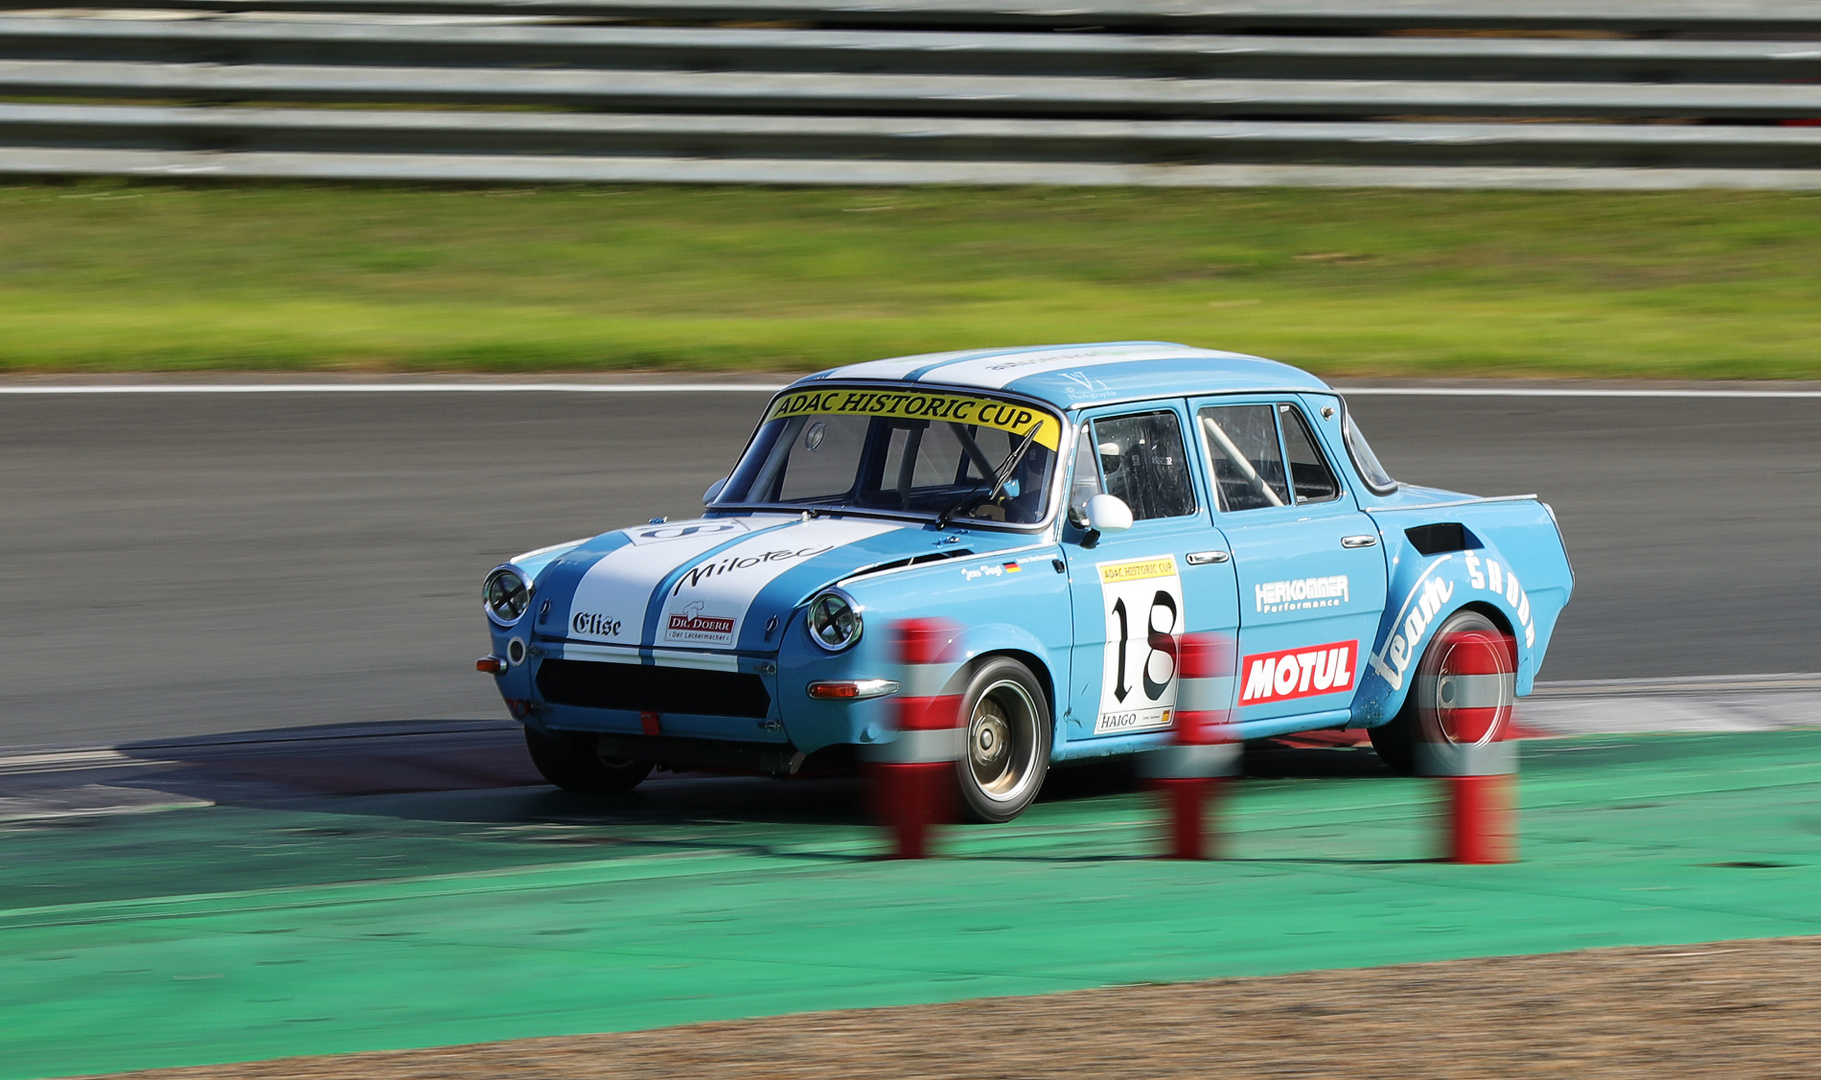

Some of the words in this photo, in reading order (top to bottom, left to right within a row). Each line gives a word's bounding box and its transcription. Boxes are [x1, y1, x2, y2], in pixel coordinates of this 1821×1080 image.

[773, 393, 838, 417] ADAC
[837, 393, 973, 419] HISTORIC
[978, 404, 1032, 429] CUP
[673, 545, 834, 597] Milotec
[1104, 567, 1124, 579] ADAC
[1124, 564, 1158, 577] HISTORIC
[1158, 562, 1172, 573] CUP
[1255, 575, 1349, 612] HERKOMMER
[1263, 599, 1340, 613] Performance
[573, 612, 622, 637] Elise
[671, 618, 690, 628] DR.
[692, 618, 730, 631] DOERR
[1369, 555, 1454, 690] team
[1112, 590, 1177, 704] 18
[1243, 647, 1351, 700] MOTUL
[1101, 713, 1137, 728] HAIGO
